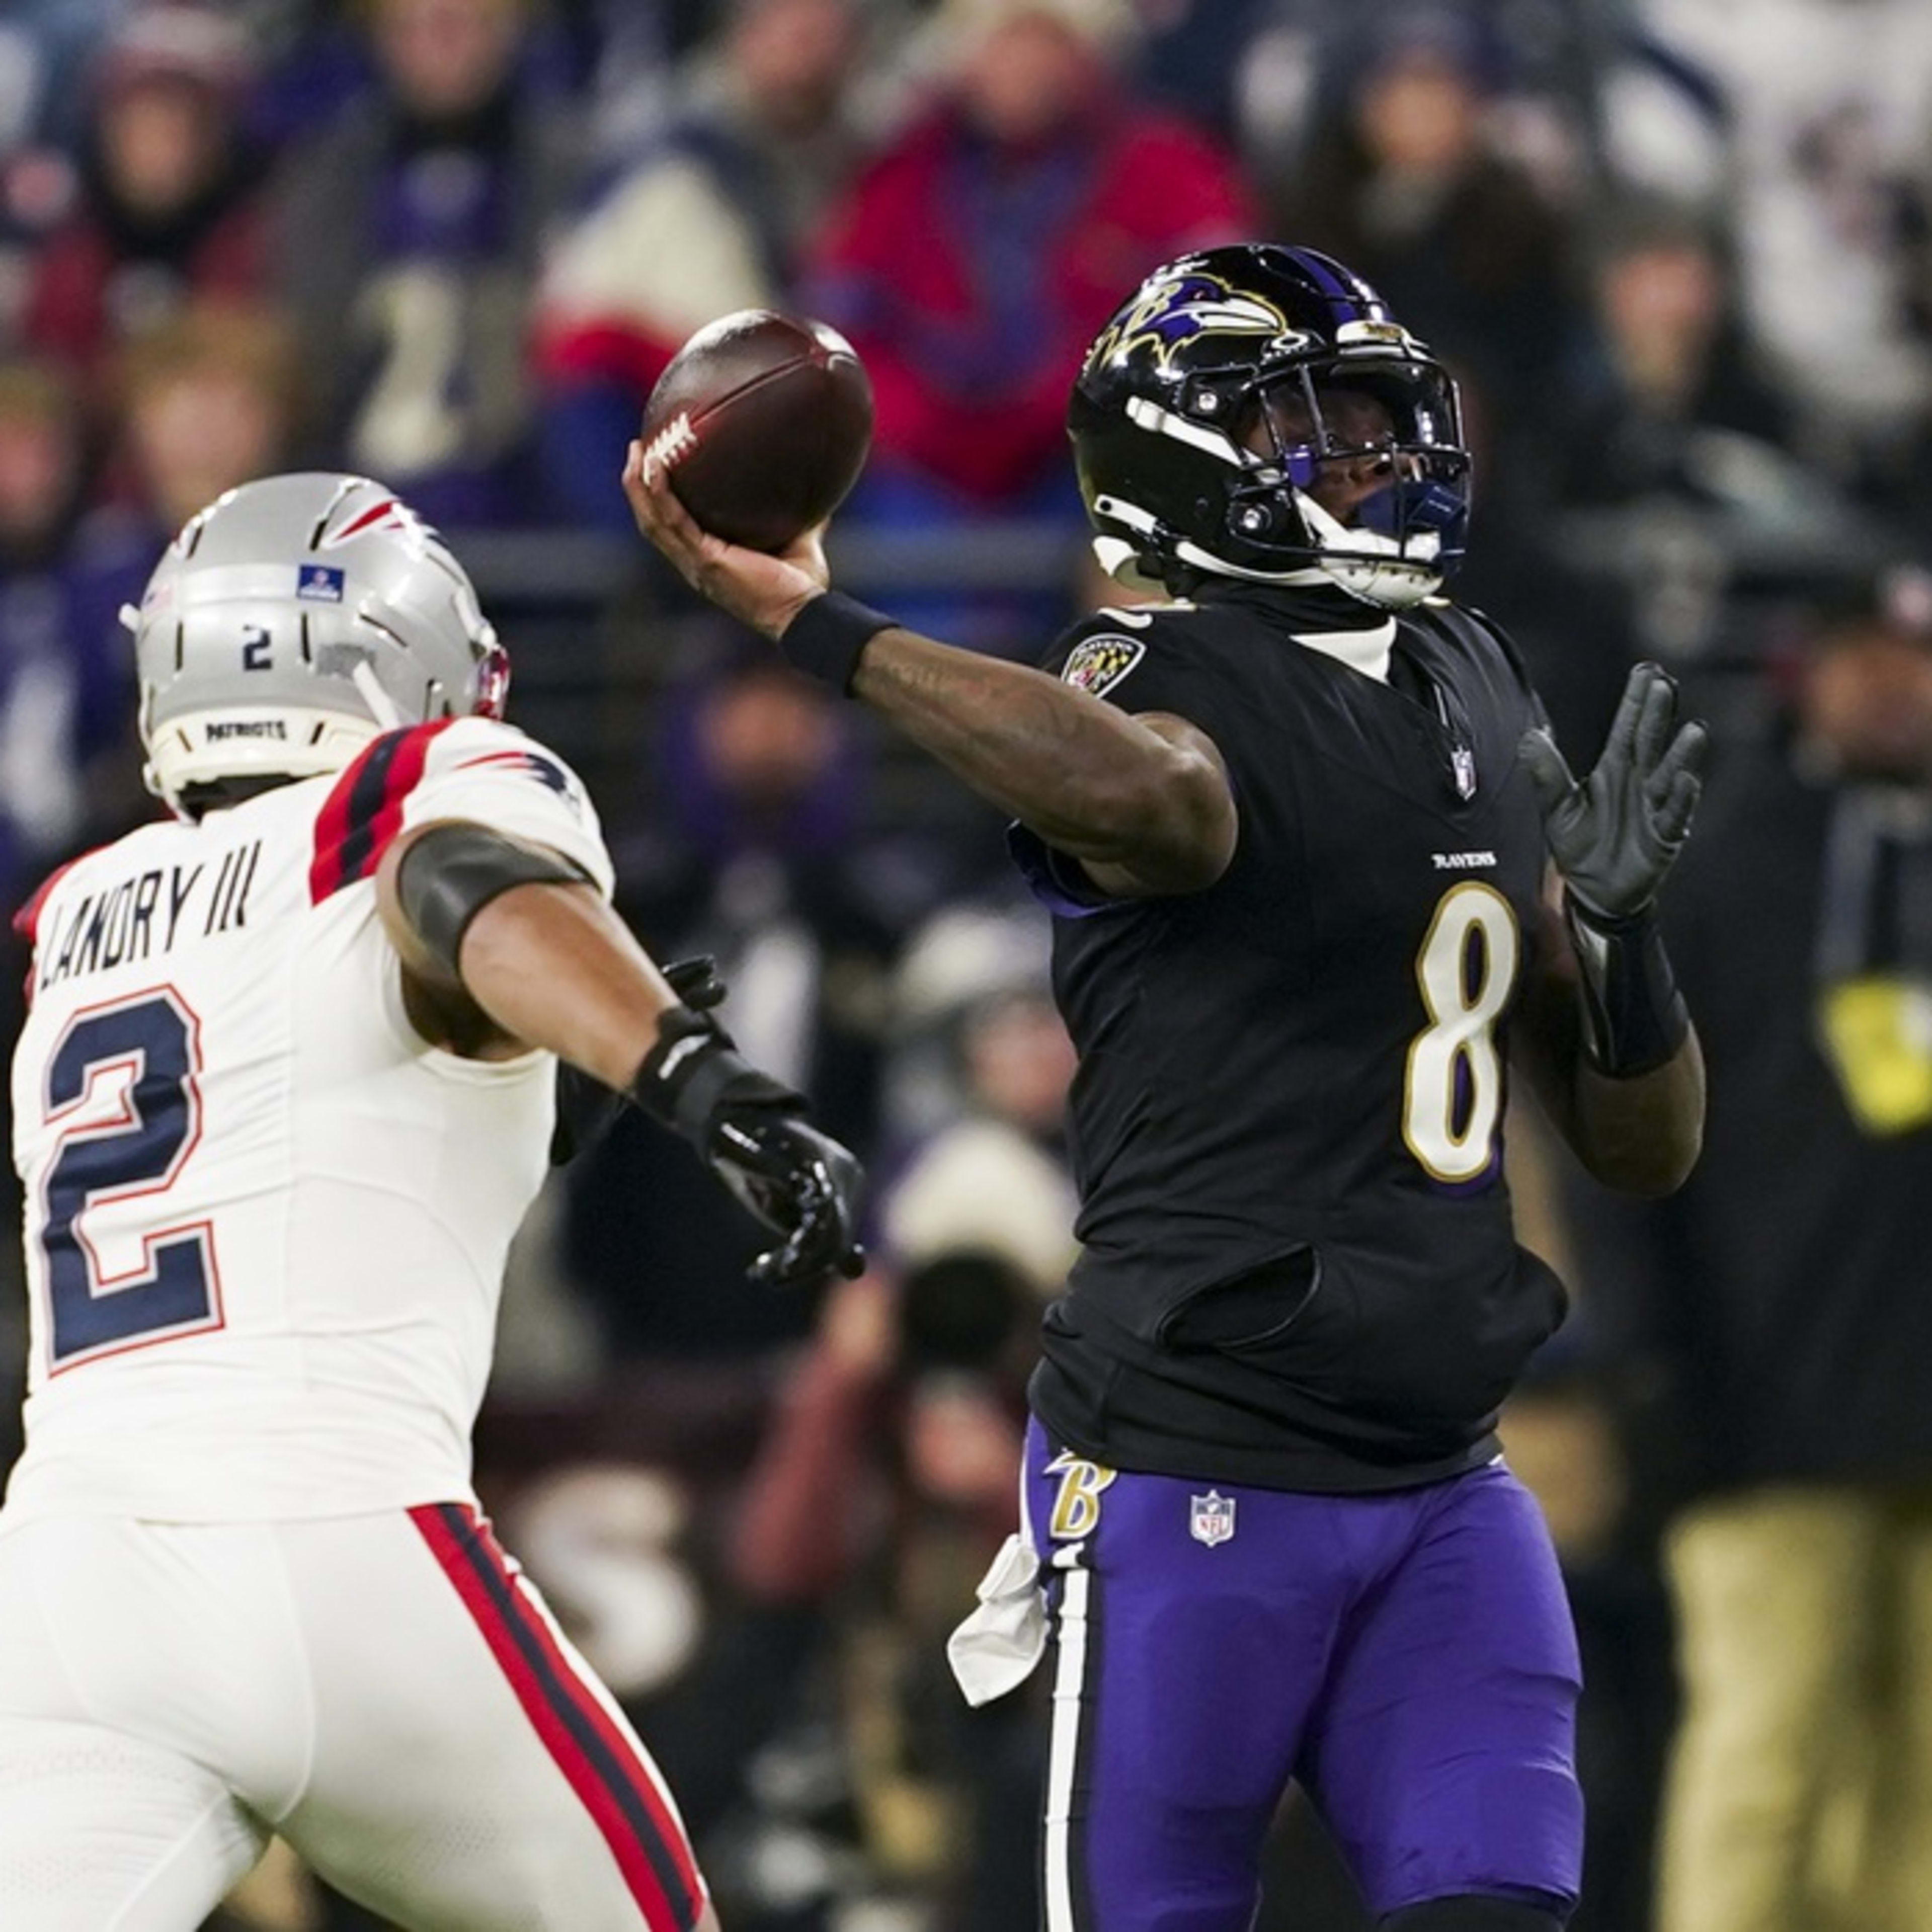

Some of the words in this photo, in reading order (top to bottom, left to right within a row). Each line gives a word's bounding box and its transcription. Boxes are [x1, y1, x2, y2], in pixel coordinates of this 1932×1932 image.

[243, 624, 272, 671] 2
[206, 720, 287, 743] PATRIOTS
[38, 861, 205, 991] LANDRY
[204, 839, 262, 937] III
[1402, 880, 1520, 1183] 8
[37, 983, 226, 1379] 2
[1044, 1448, 1117, 1540] B
